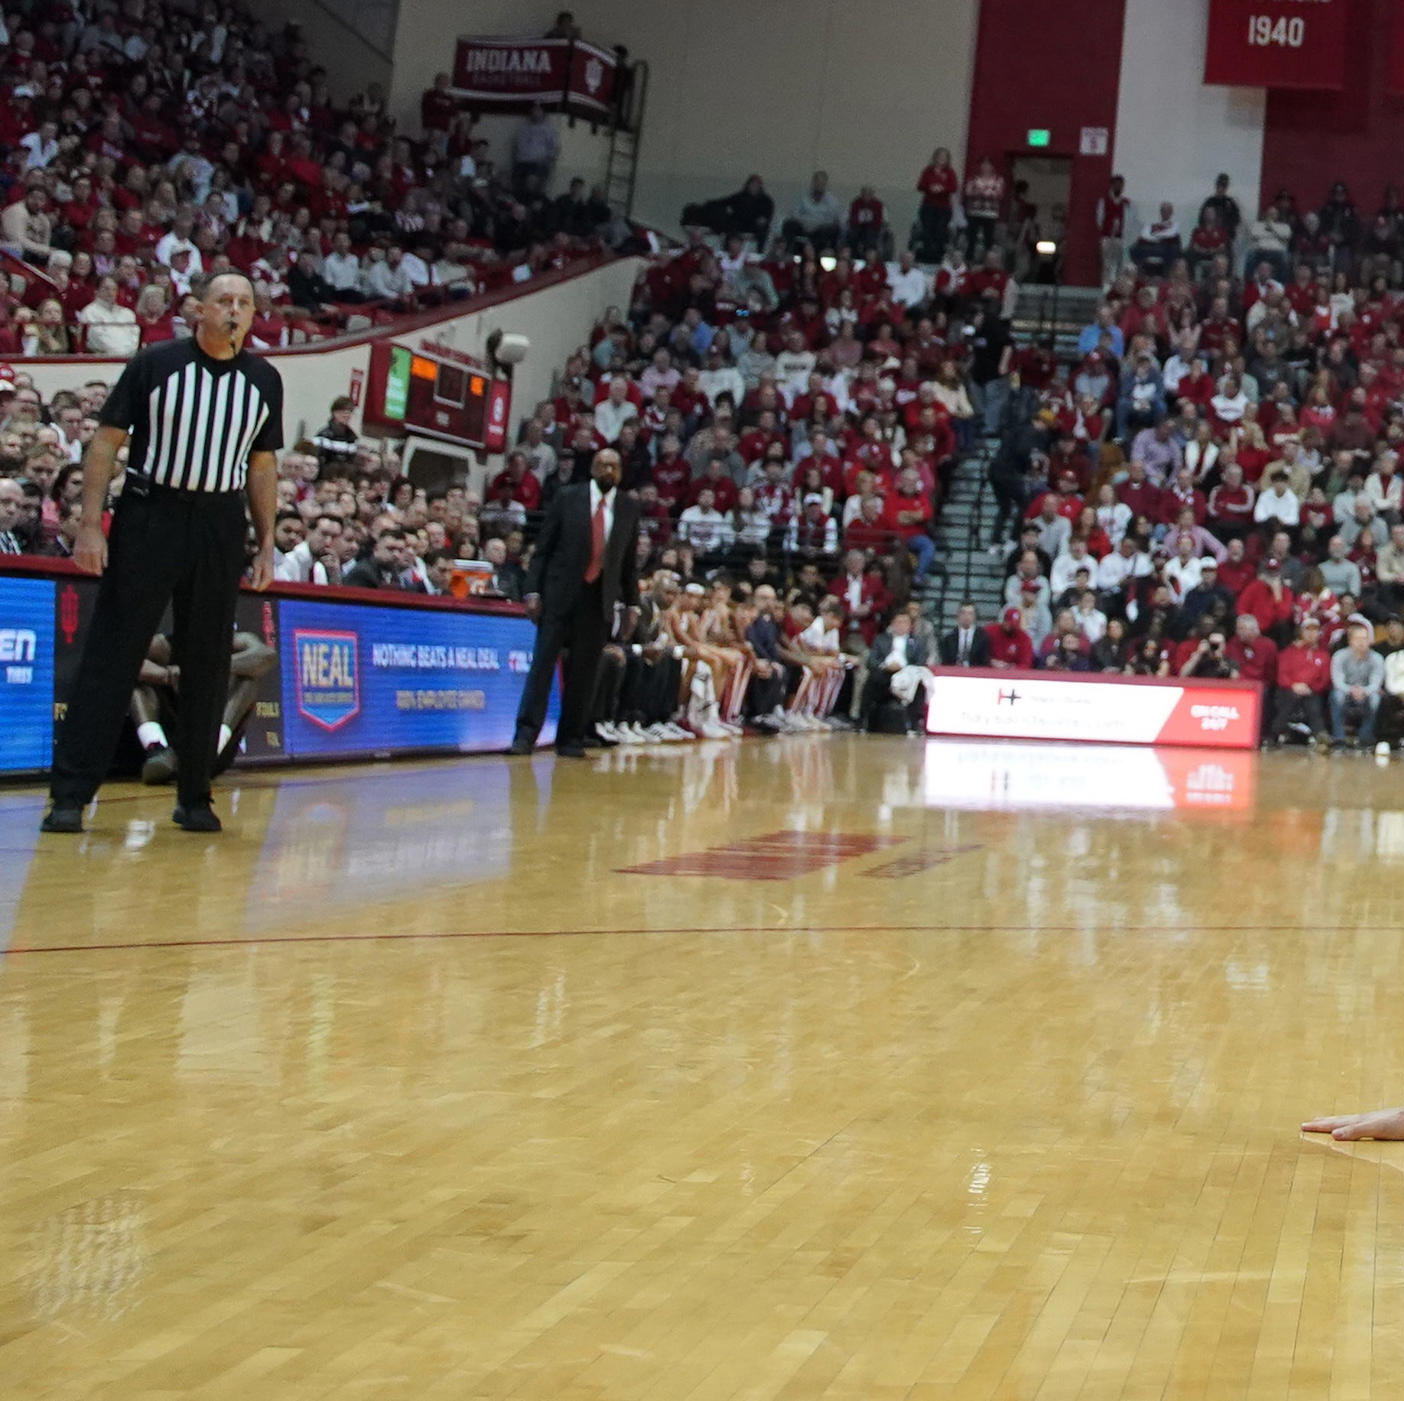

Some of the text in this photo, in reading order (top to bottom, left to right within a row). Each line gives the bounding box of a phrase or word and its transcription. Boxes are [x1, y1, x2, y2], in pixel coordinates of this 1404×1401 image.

[1248, 15, 1304, 48] 1940
[466, 50, 551, 73] INDIANA
[302, 642, 354, 687] NEAL
